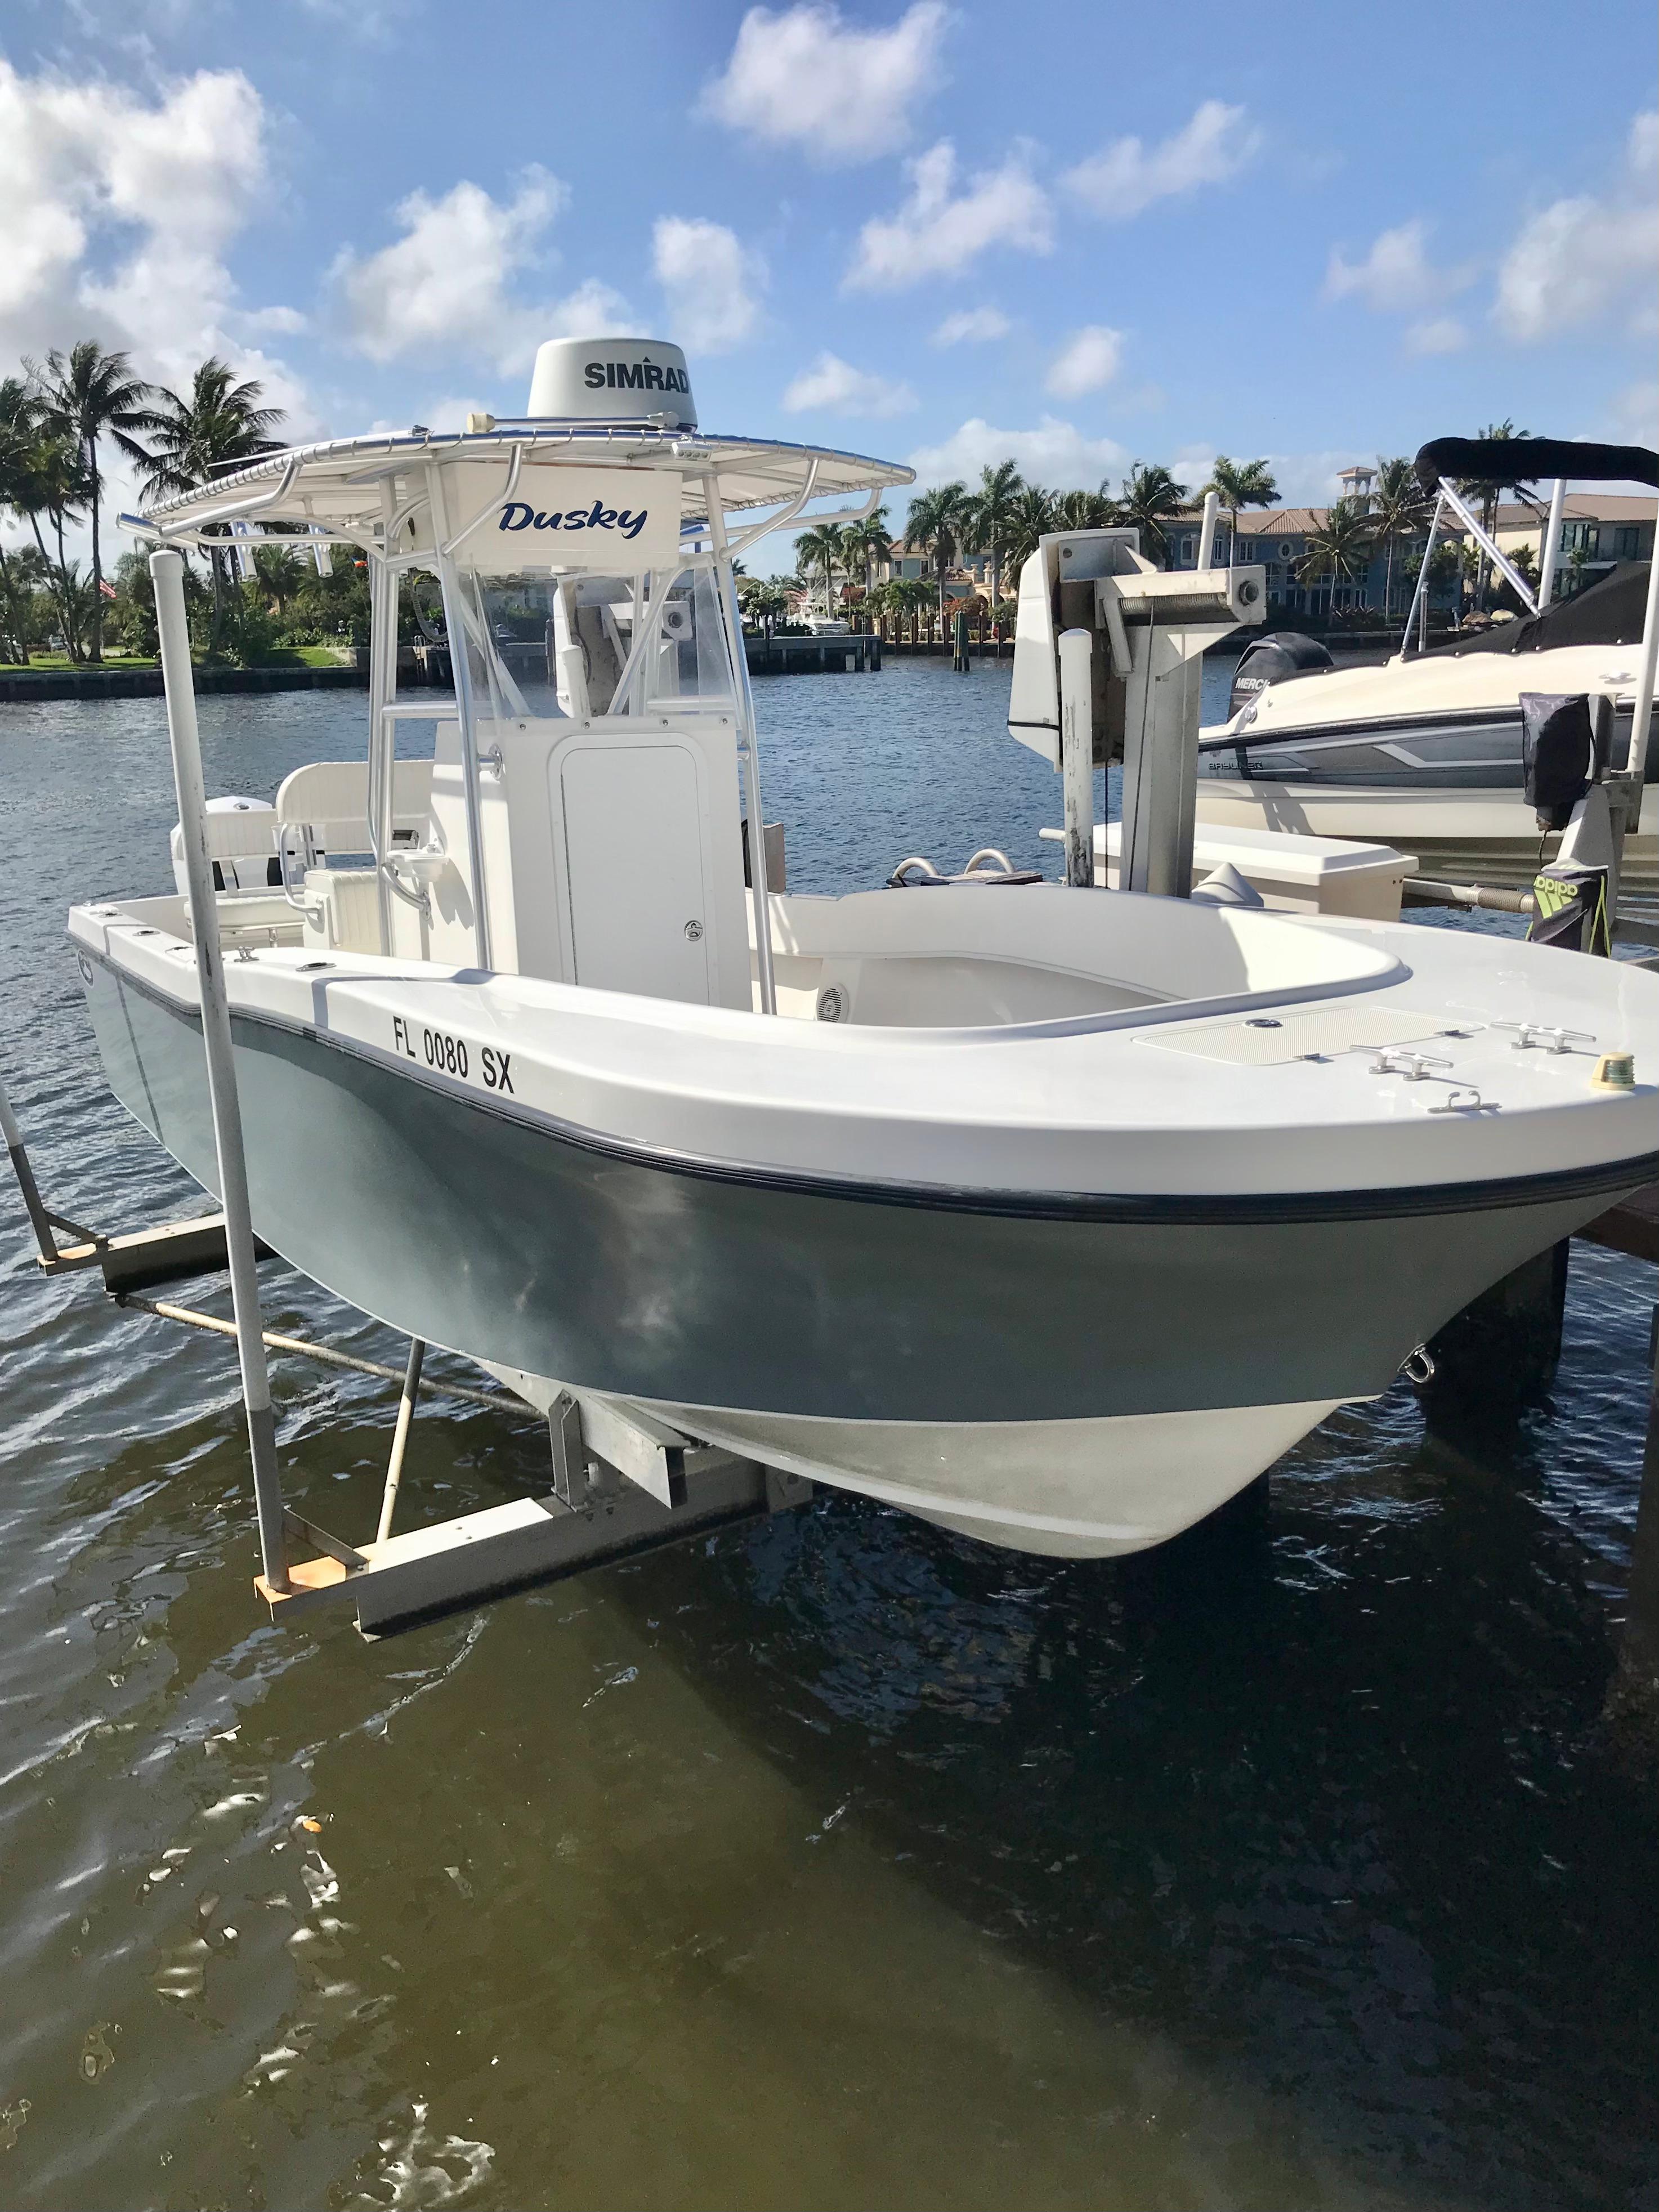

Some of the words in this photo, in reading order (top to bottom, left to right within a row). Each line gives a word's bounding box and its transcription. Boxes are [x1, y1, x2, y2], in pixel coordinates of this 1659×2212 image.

[584, 361, 689, 394] SIMRAD
[498, 501, 648, 539] Dusky
[393, 1016, 416, 1058] FL
[424, 1029, 468, 1078] 0080
[481, 1047, 515, 1094] SX
